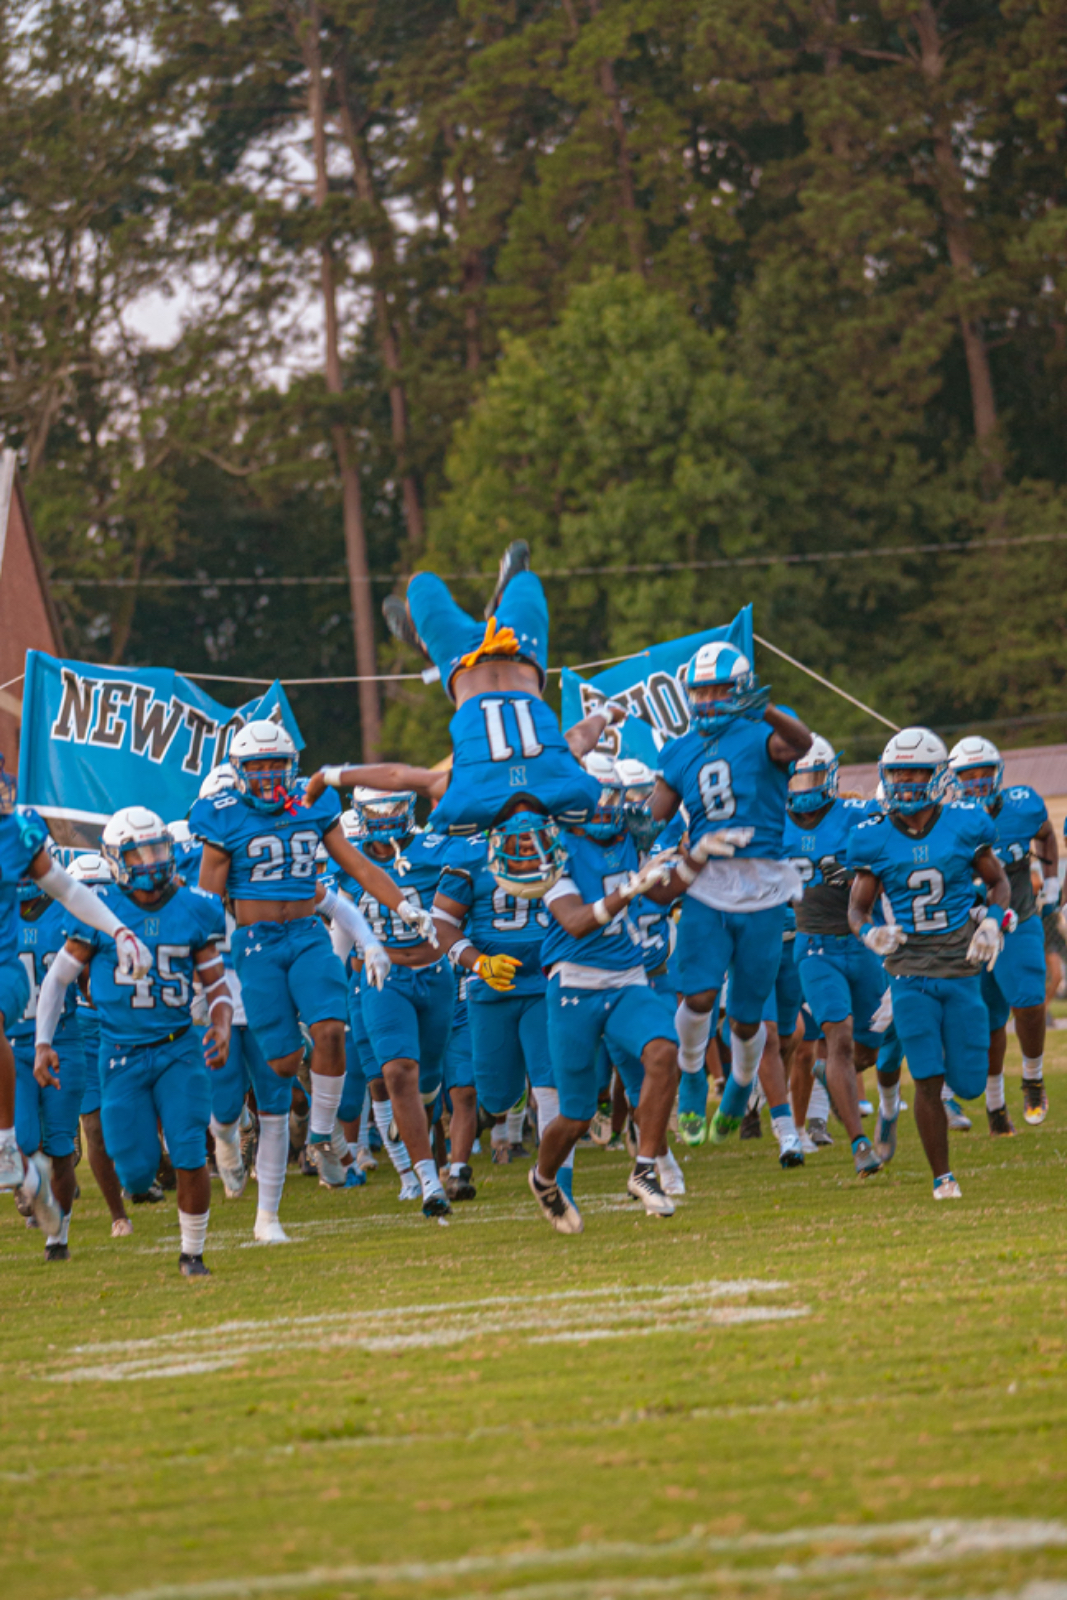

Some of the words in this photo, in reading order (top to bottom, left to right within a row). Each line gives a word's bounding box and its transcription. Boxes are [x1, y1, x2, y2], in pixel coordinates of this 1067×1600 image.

[480, 698, 544, 762] 11
[509, 765, 527, 786] N
[699, 758, 736, 821] 8
[247, 831, 319, 882] 28
[908, 868, 948, 932] 2
[114, 944, 192, 1009] 45
